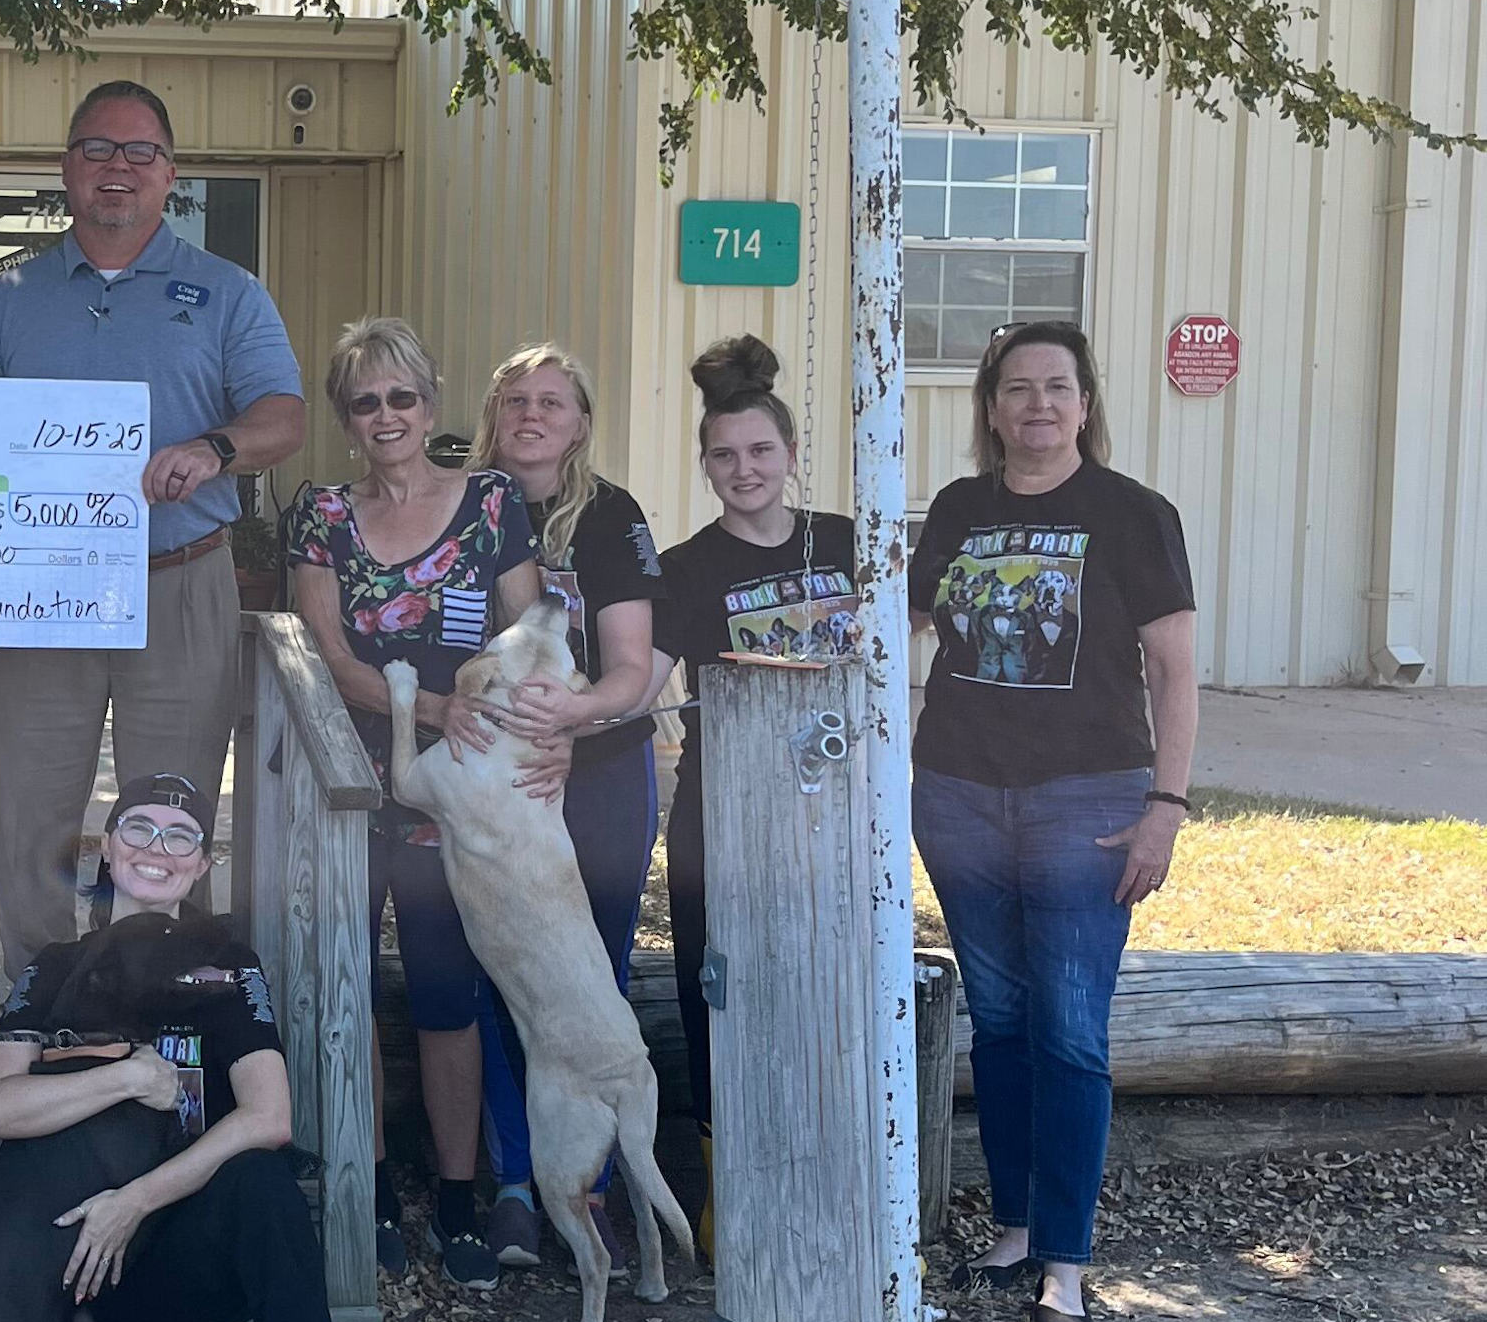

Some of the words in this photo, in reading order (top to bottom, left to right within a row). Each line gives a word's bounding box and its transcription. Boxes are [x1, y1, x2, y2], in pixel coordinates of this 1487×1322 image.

[22, 203, 67, 230] 714
[713, 227, 761, 259] 714
[1180, 324, 1229, 343] STOP
[14, 494, 78, 527] 5,000
[1029, 532, 1086, 553] PARK
[48, 553, 82, 564] Dollars
[725, 582, 779, 612] BARK
